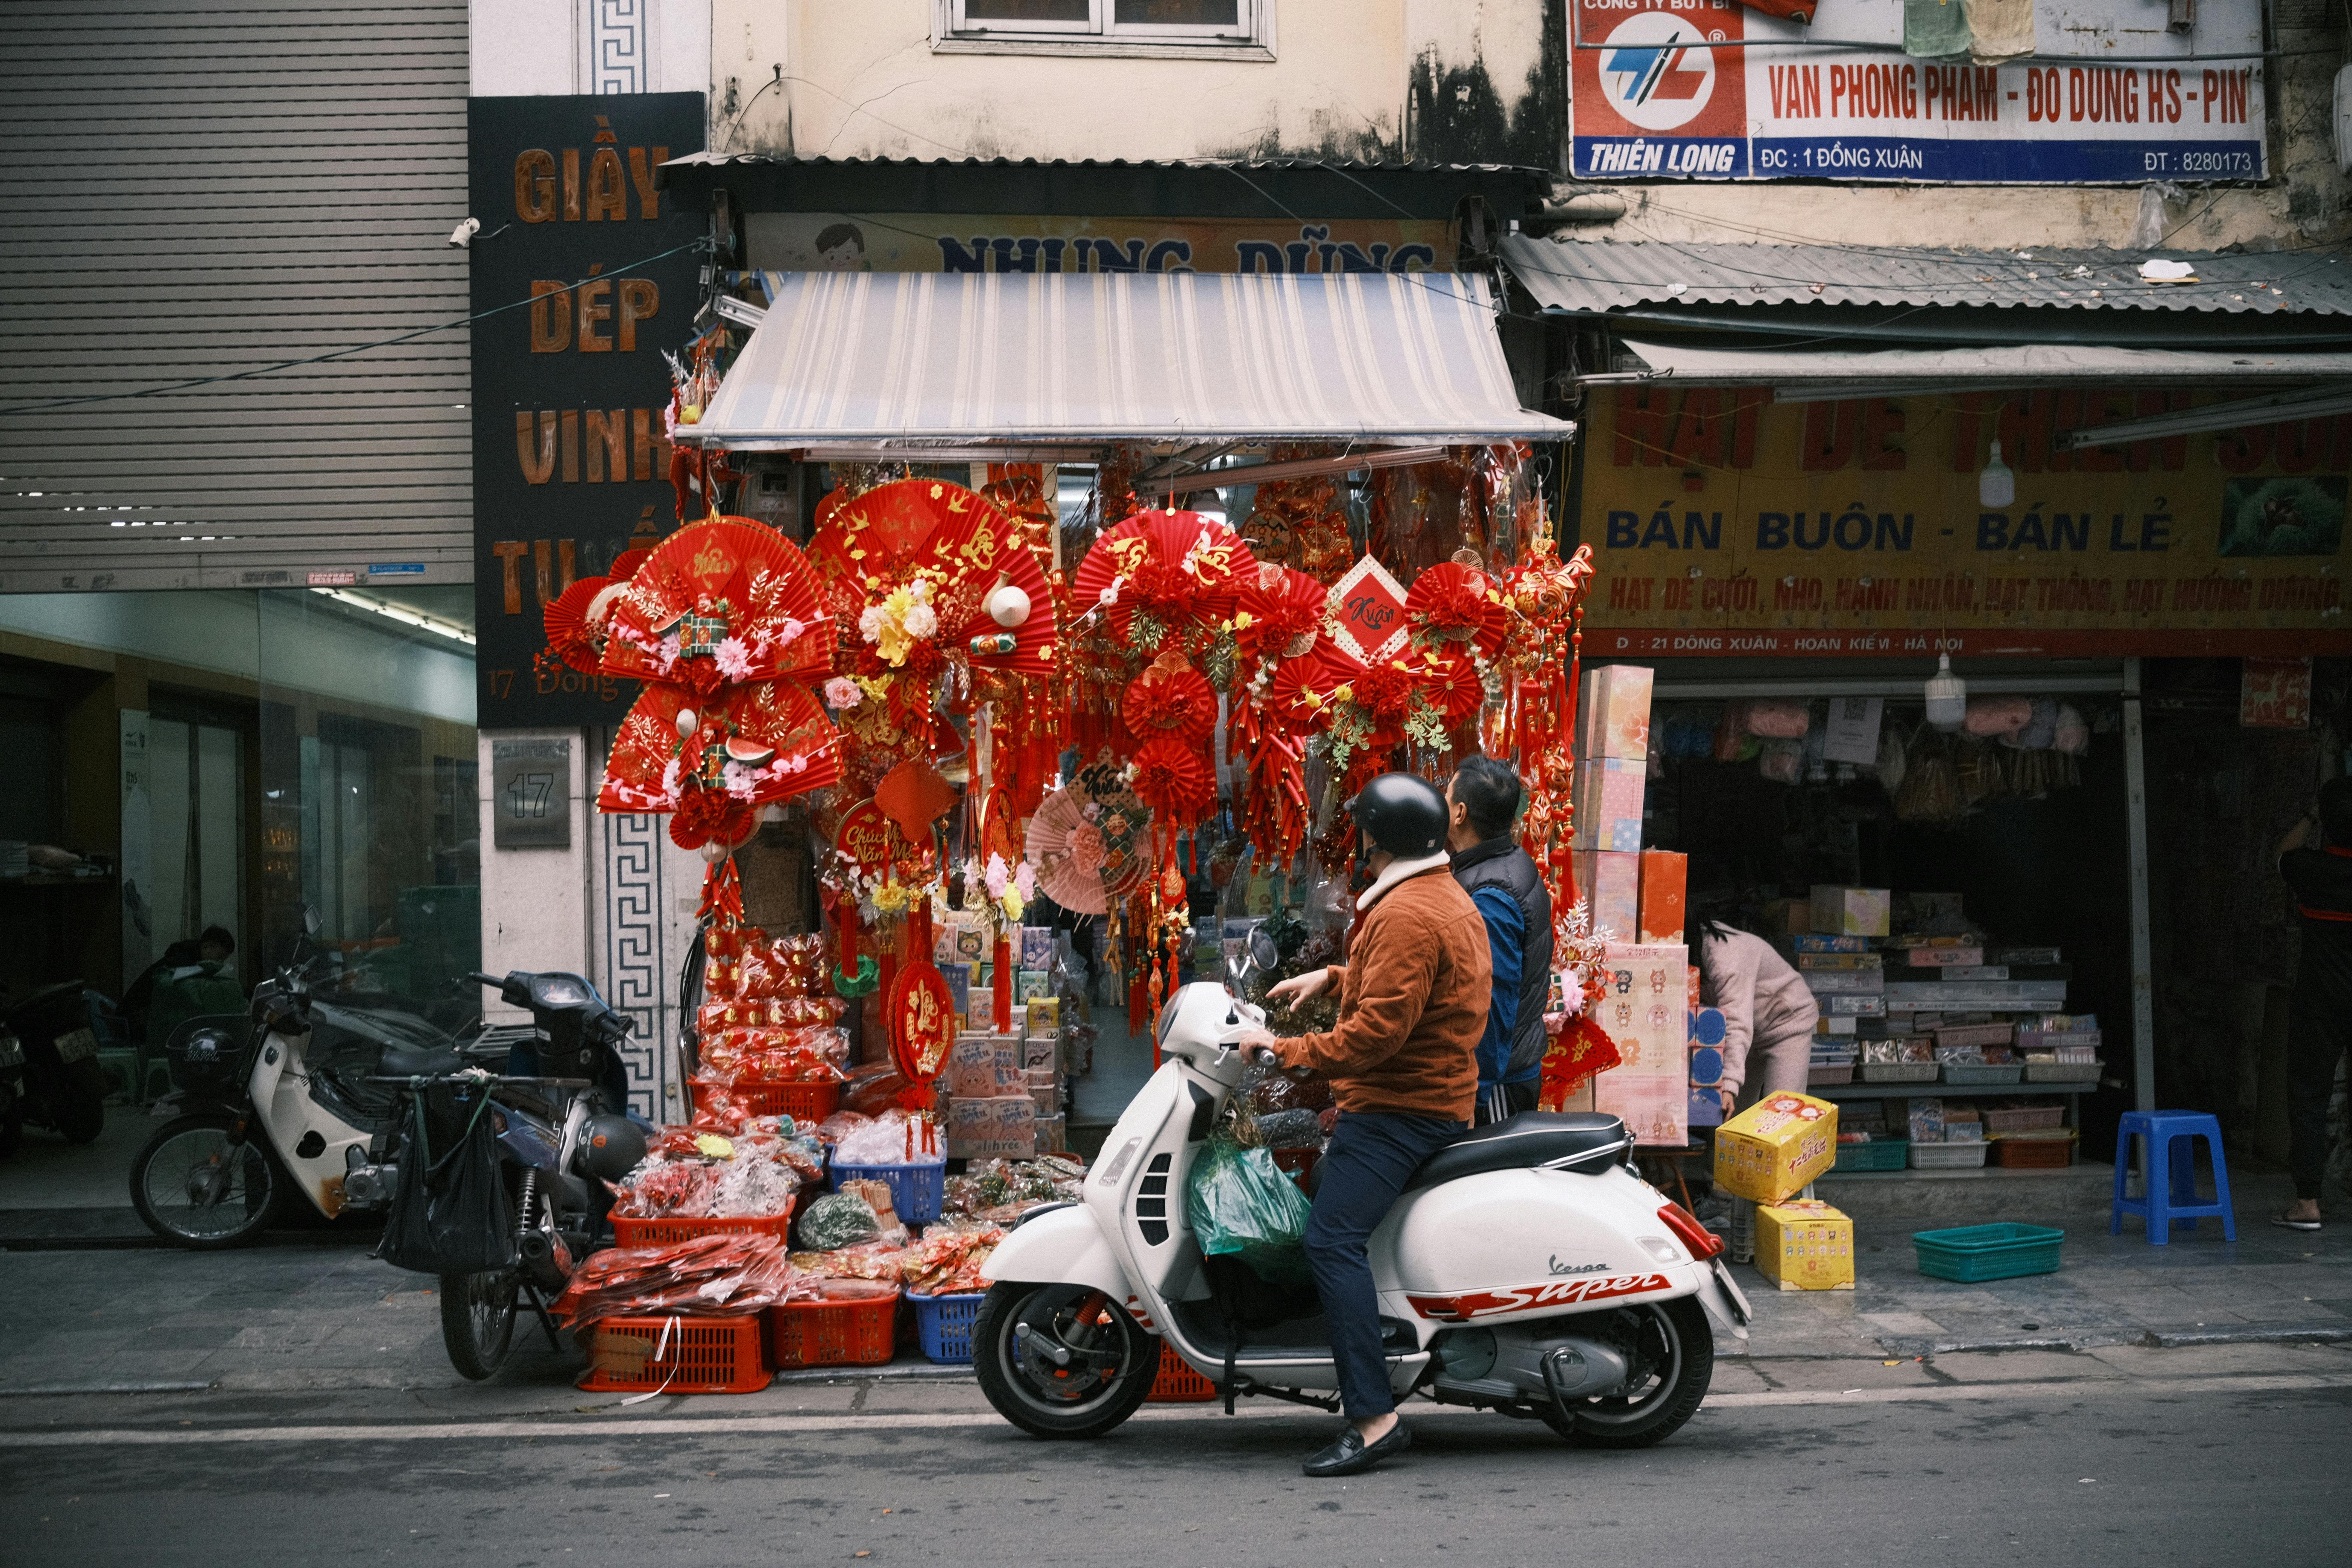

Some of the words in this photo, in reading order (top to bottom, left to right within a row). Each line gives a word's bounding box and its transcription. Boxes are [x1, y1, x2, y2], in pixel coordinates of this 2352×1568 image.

[2147, 68, 2182, 124] HS
[2202, 69, 2247, 124] PIN
[1589, 138, 1664, 172] THIÊN
[1666, 144, 1736, 172] LONG
[1761, 149, 1788, 168] ĐC
[1803, 147, 1811, 167] 1
[1817, 141, 1871, 168] ĐỒNG
[1875, 144, 1922, 169] XUÂN
[2144, 152, 2168, 171] ĐT
[2183, 152, 2252, 172] 8280173
[531, 263, 660, 353] DÉP
[516, 408, 673, 485] VINH
[1606, 500, 1723, 551] BÁN
[1756, 502, 1914, 551] BUÔN
[1975, 502, 2090, 551] BÁN
[2110, 497, 2173, 551] LẺ
[1347, 597, 1395, 630] Xuân
[1609, 577, 1655, 616] HẠT
[1835, 577, 1901, 617] HẠNH
[1985, 577, 2030, 617] HẠT
[2124, 579, 2166, 618] HẠT
[1651, 638, 1668, 649] 21
[1729, 635, 1778, 651] XUÂN
[1905, 634, 1927, 651] HÀ
[490, 670, 515, 700] 17
[508, 773, 554, 818] 17
[1549, 1254, 1612, 1276] Vespa
[1471, 1274, 1660, 1316] Super
